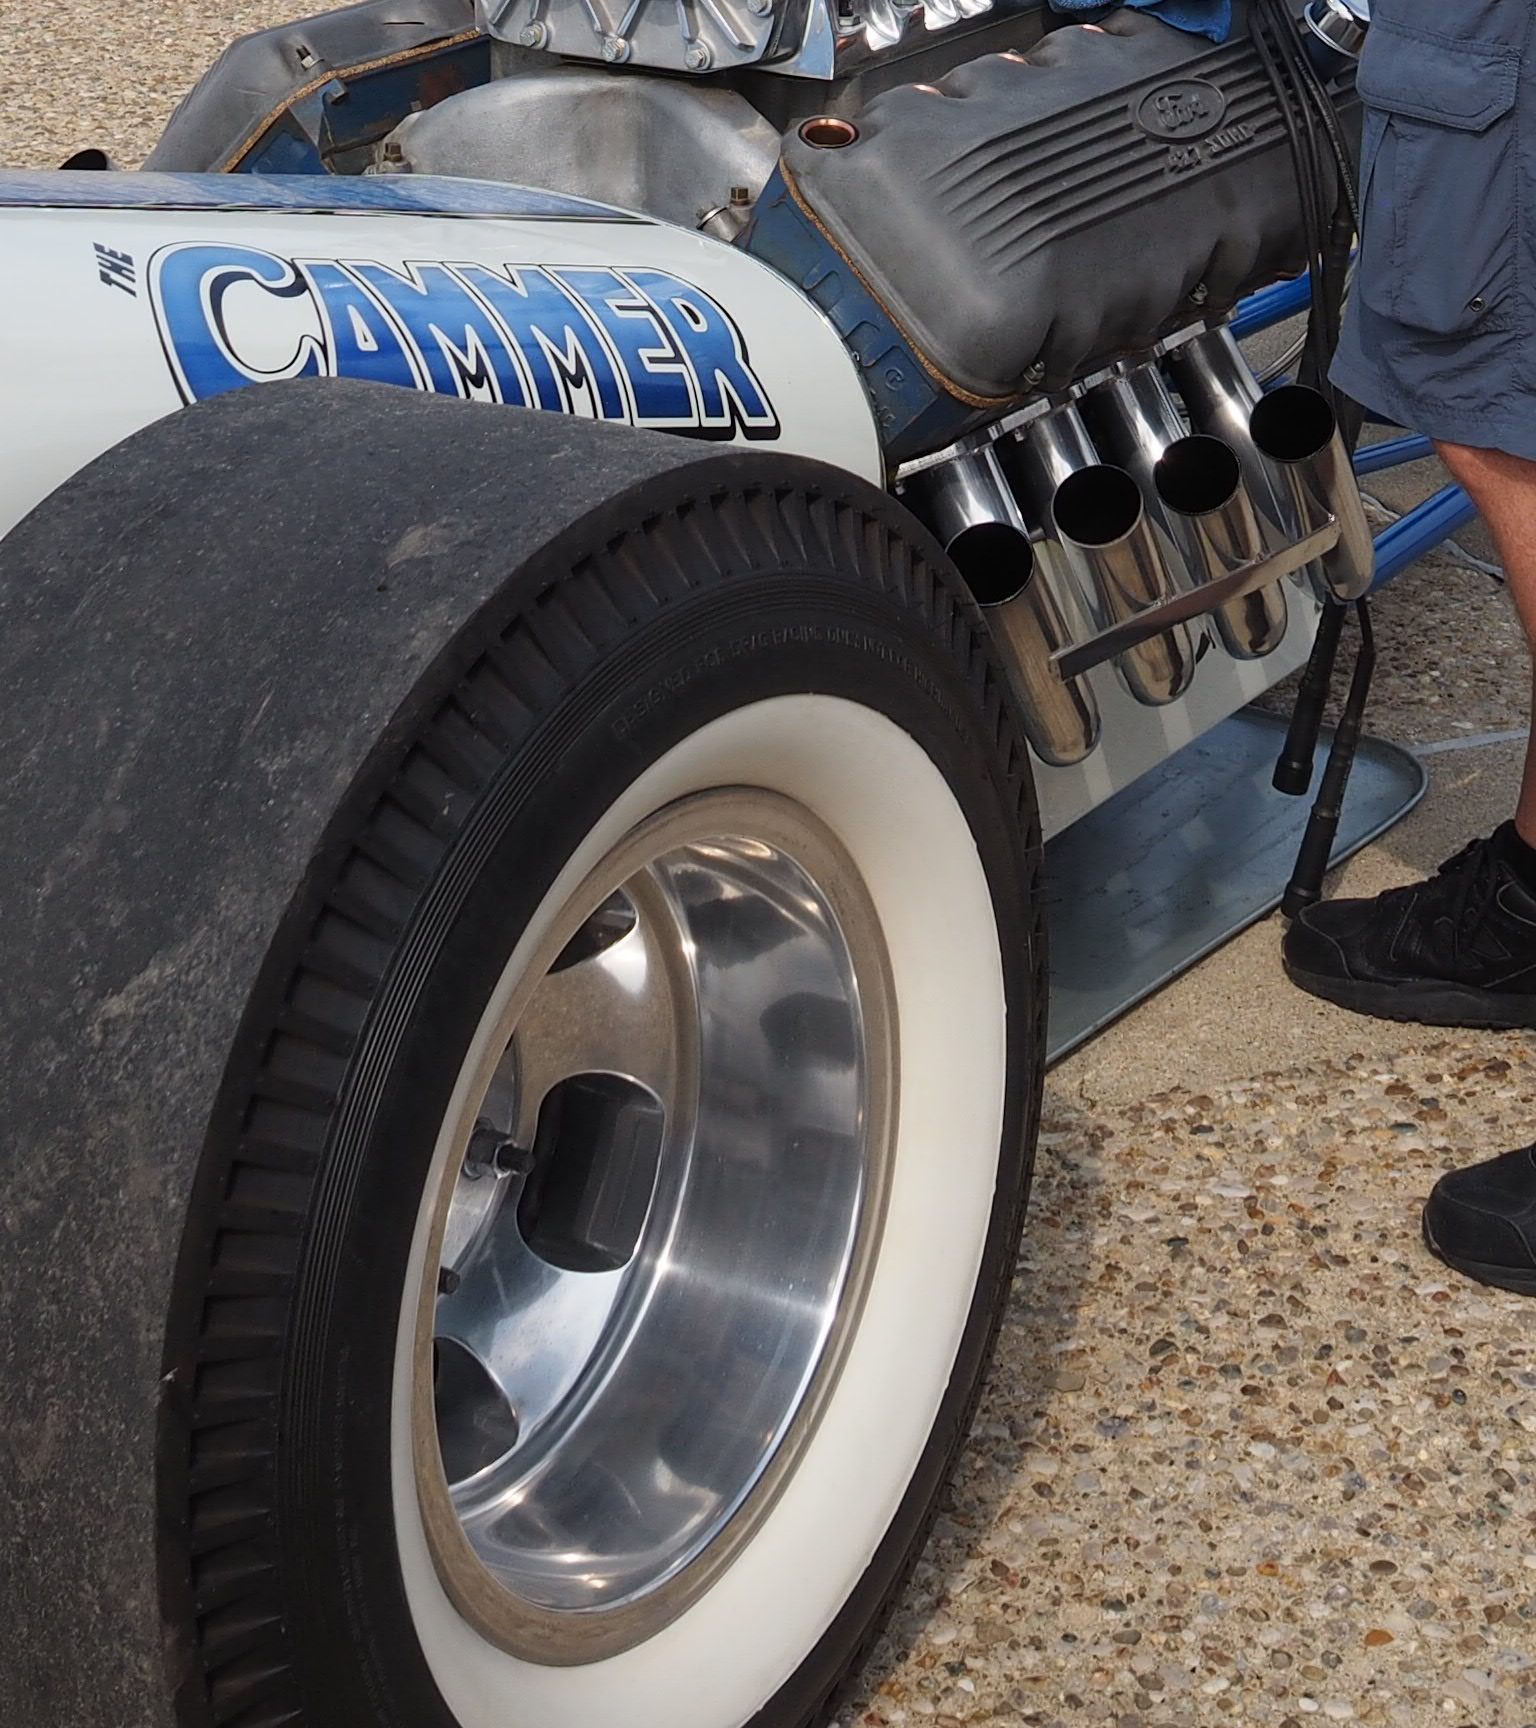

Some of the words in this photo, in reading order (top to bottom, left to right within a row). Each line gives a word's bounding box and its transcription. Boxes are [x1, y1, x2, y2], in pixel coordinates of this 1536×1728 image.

[1152, 91, 1210, 130] Ford
[91, 240, 139, 298] THE
[146, 240, 782, 442] CAMMER
